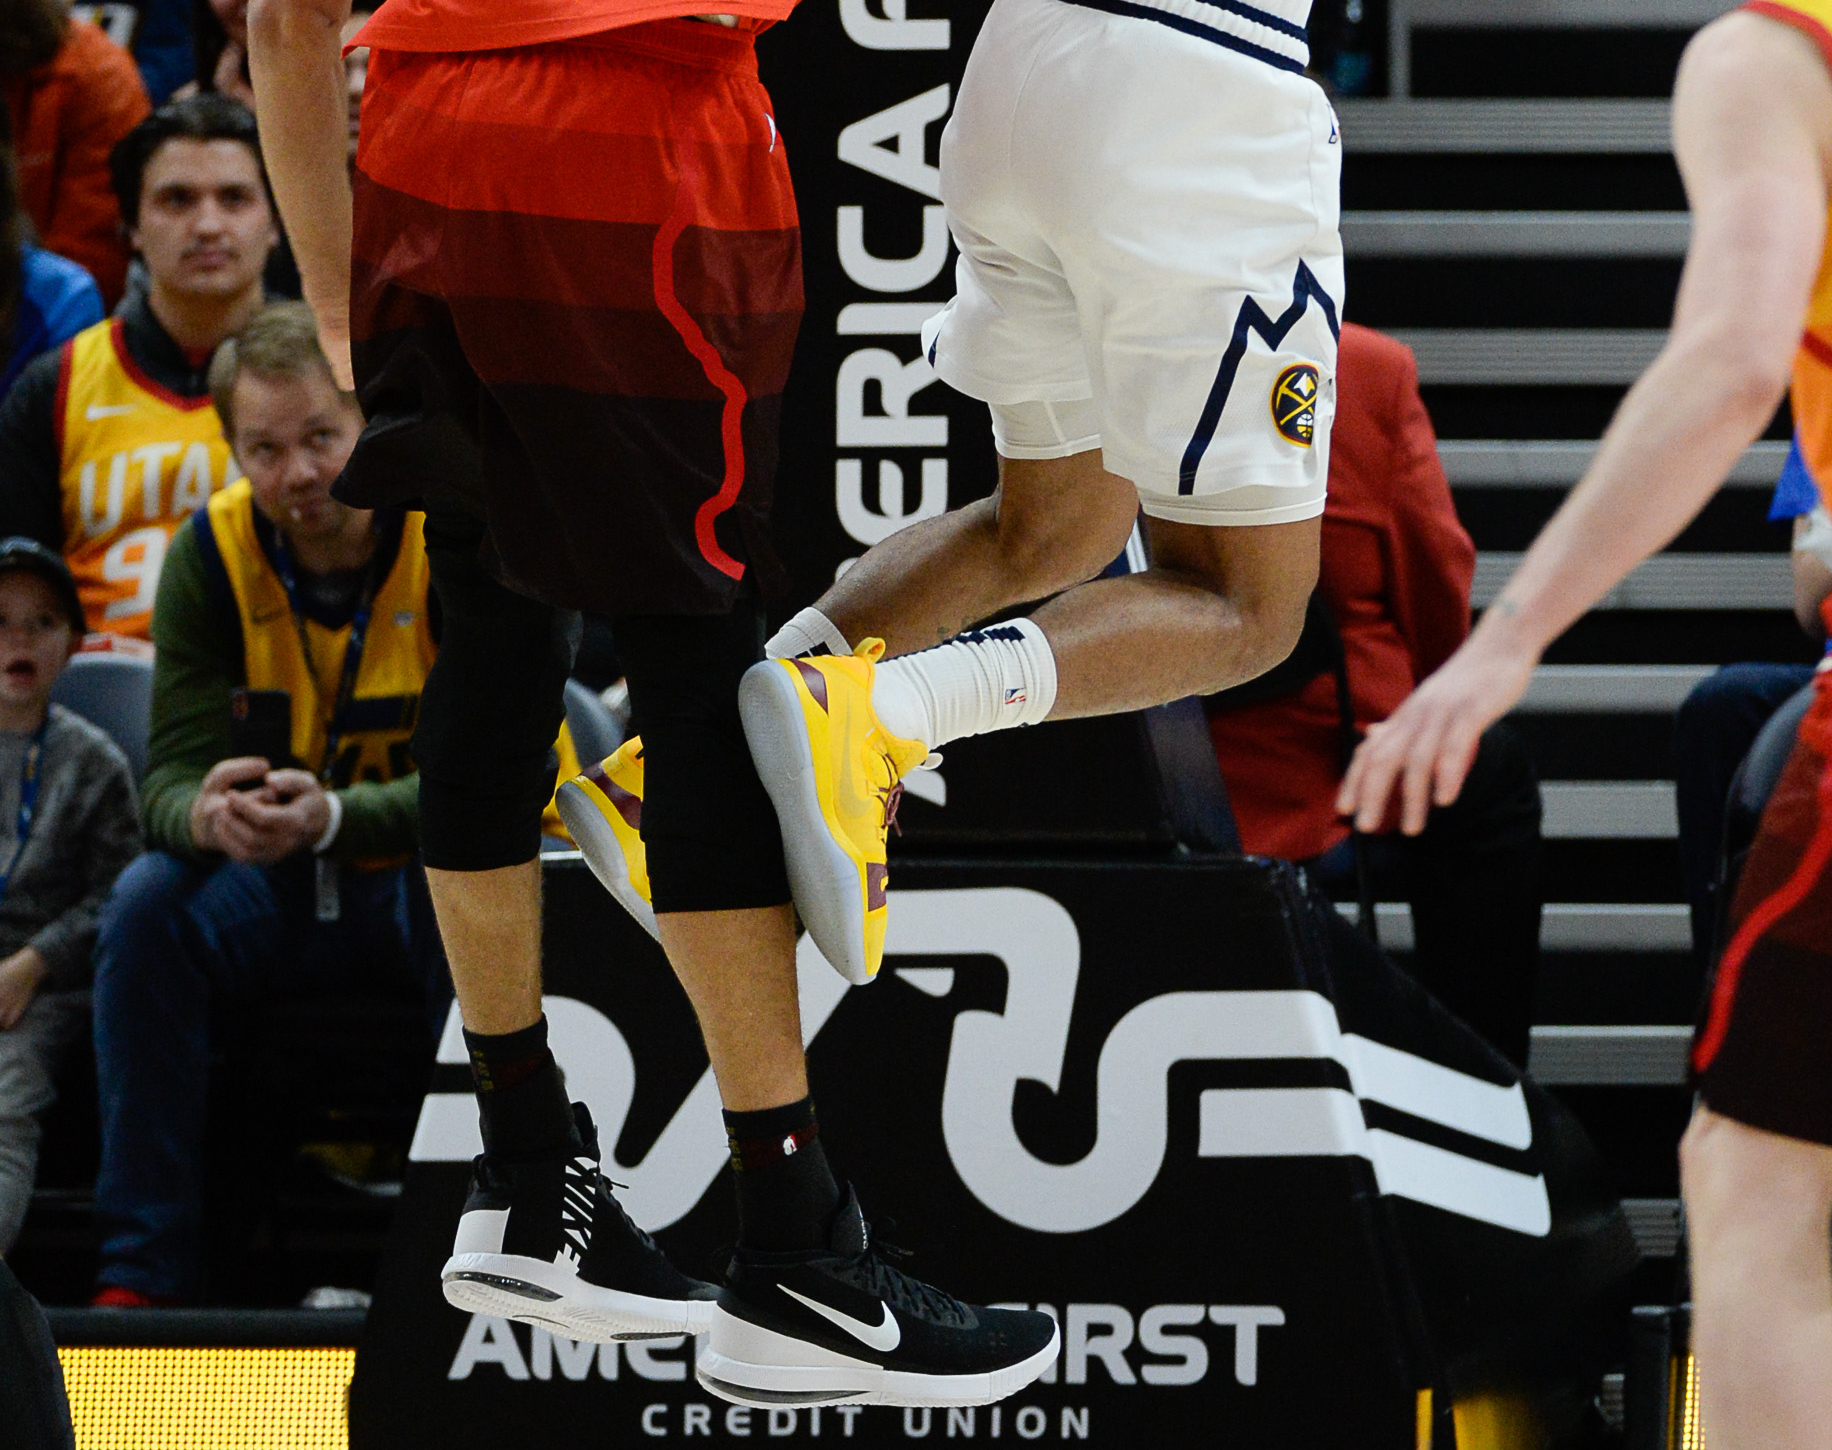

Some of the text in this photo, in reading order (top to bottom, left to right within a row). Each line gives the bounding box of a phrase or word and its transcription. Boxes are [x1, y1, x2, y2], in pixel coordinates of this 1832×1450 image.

[836, 82, 952, 808] ERICA
[641, 1403, 1090, 1440] CREDIT UNION
